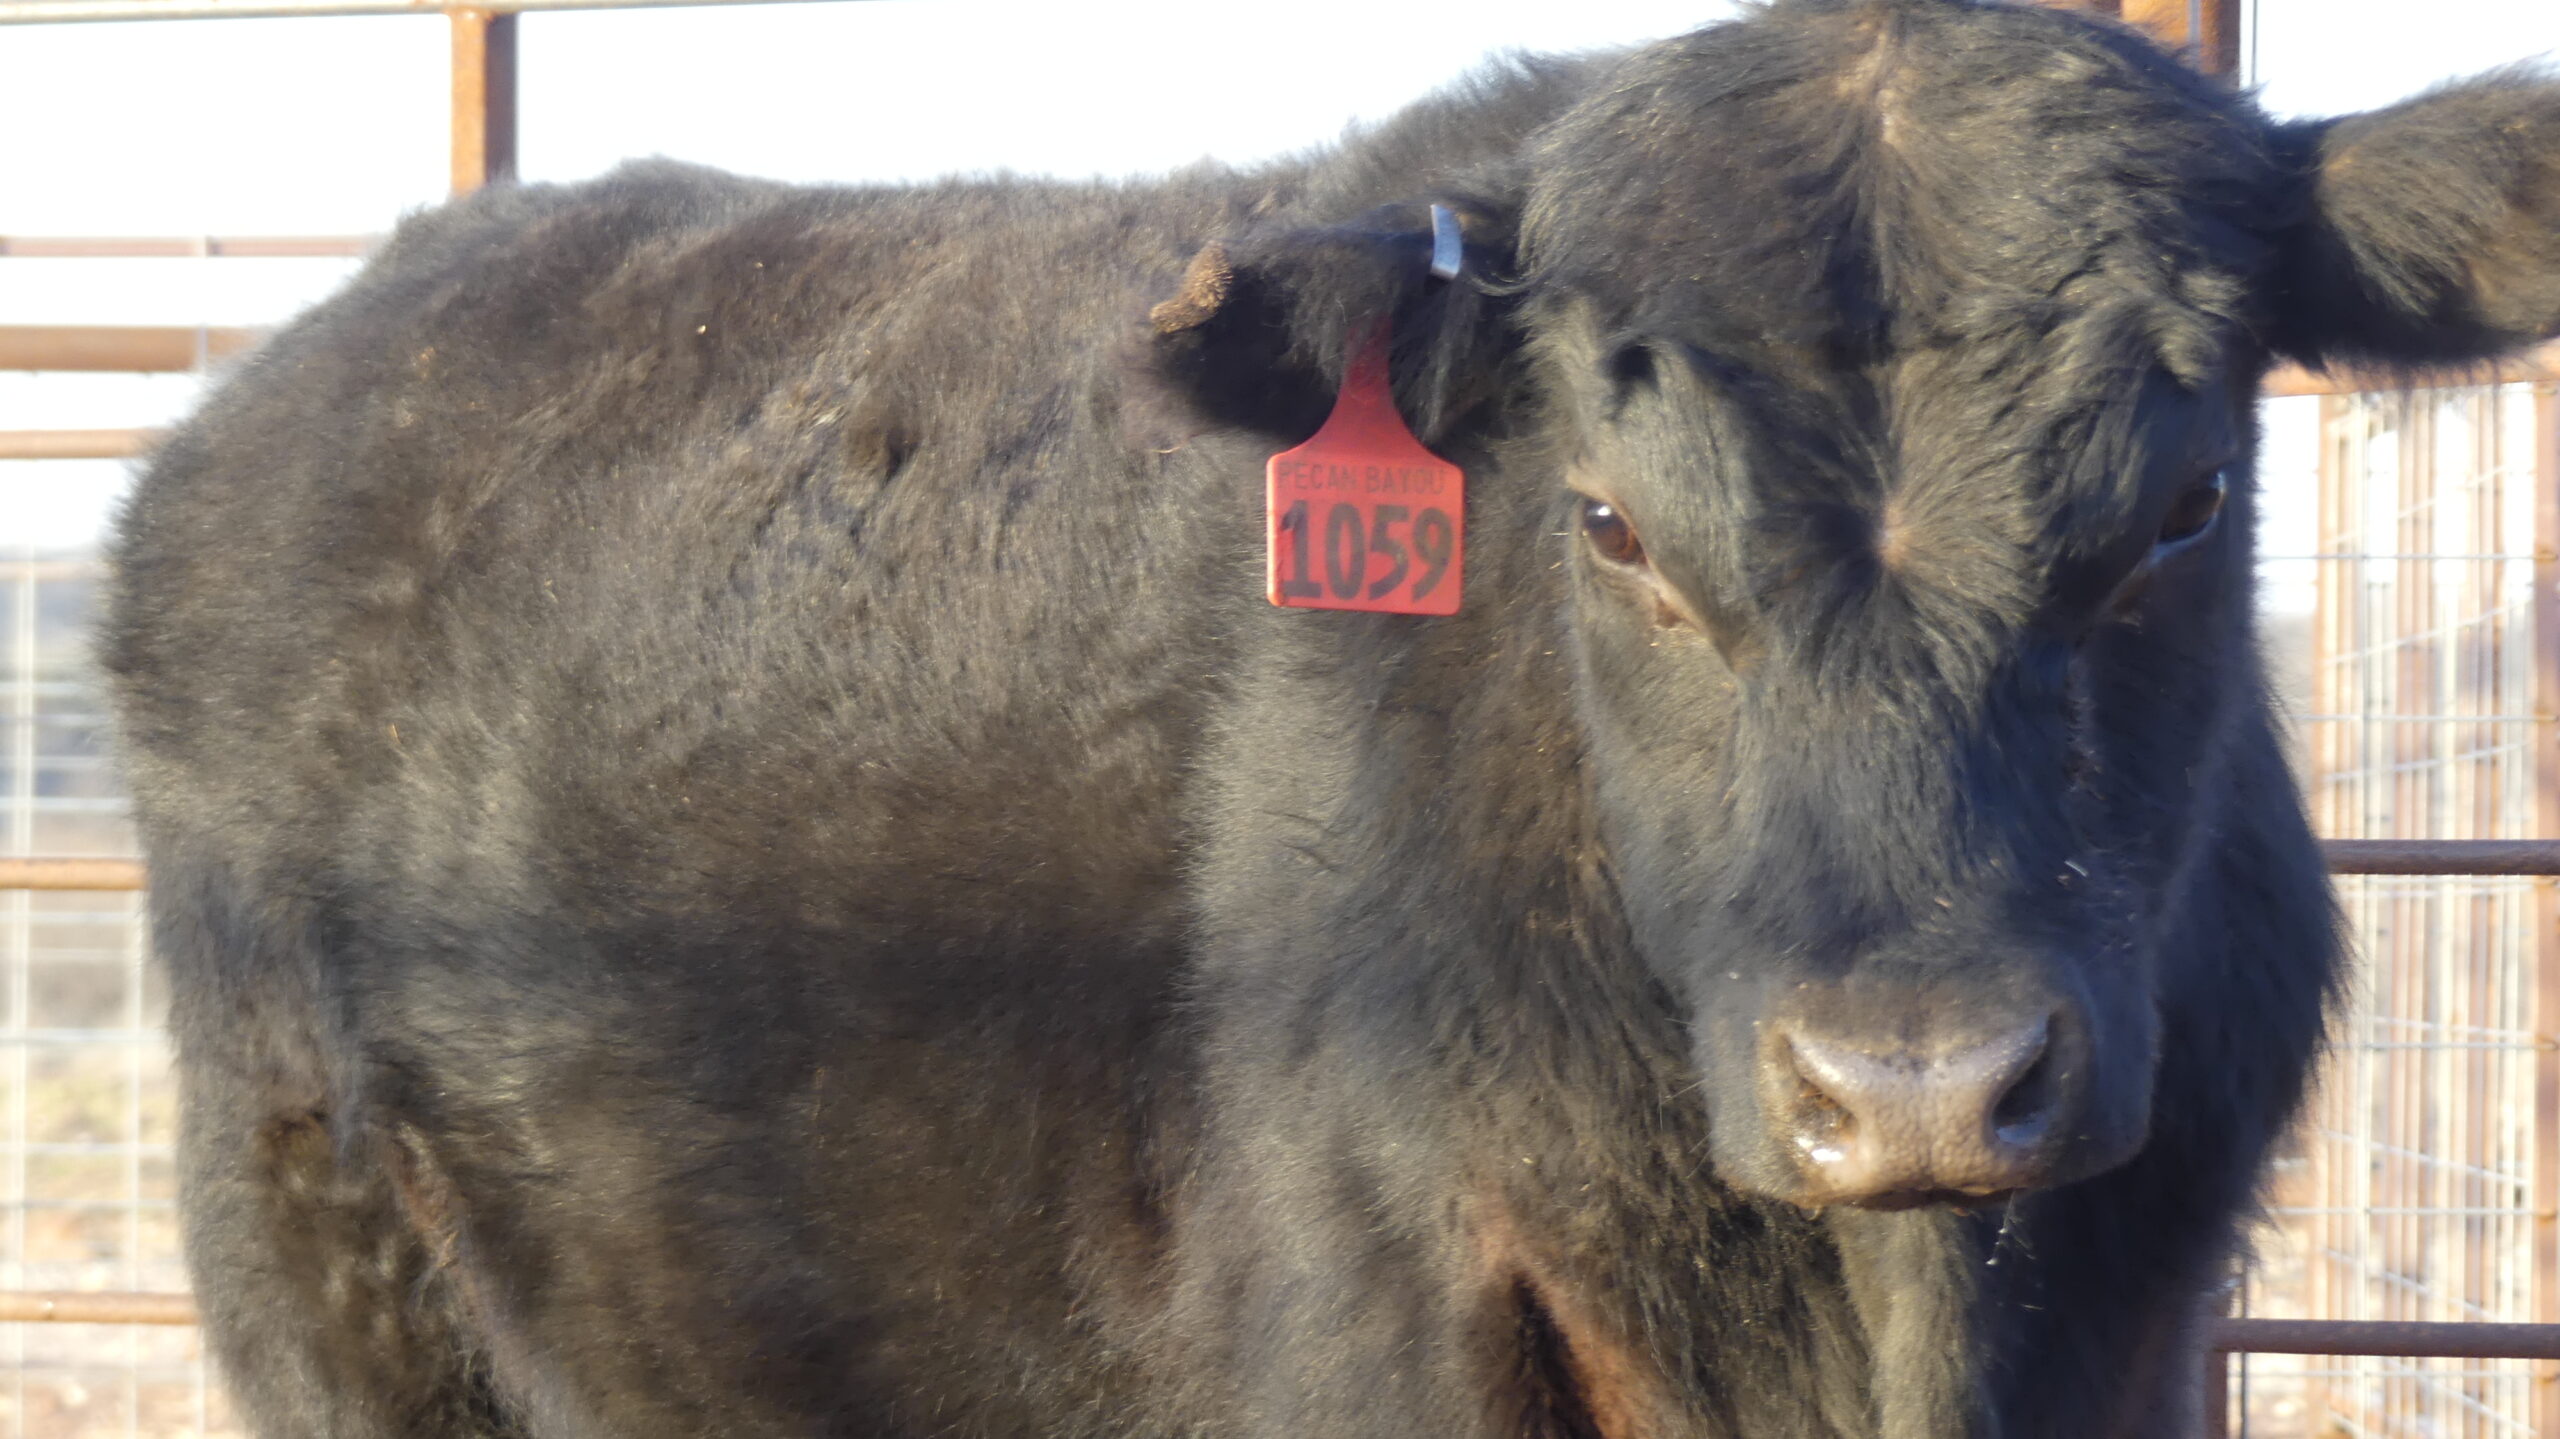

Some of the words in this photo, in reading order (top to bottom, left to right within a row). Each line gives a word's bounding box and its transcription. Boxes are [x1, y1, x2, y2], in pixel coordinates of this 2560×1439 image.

[1278, 462, 1356, 490] PECAN
[1364, 466, 1446, 495] BAYOU
[1280, 499, 1453, 603] 1059
